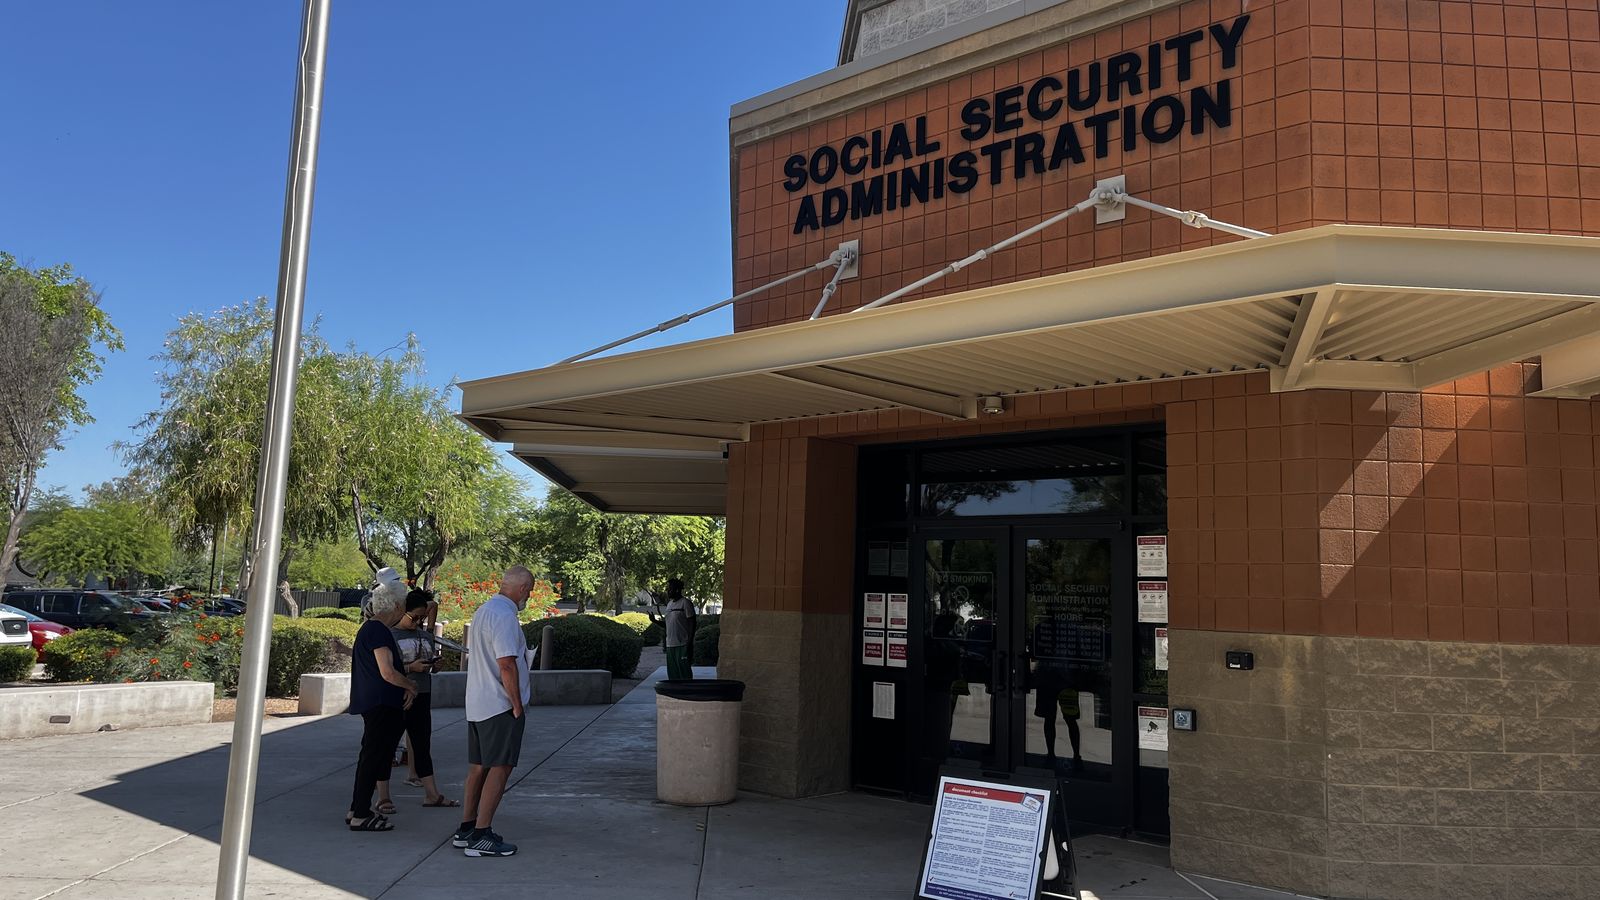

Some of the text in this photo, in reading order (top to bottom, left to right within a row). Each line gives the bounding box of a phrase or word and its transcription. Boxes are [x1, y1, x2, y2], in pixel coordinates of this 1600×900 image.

[783, 15, 1250, 193] SOCIAL SECURITY
[793, 79, 1232, 234] ADMINISTRATION
[1030, 583, 1111, 593] SOCIAL SECURITY
[1031, 594, 1109, 604] ADMINISTRATION
[1054, 613, 1083, 622] HOURS
